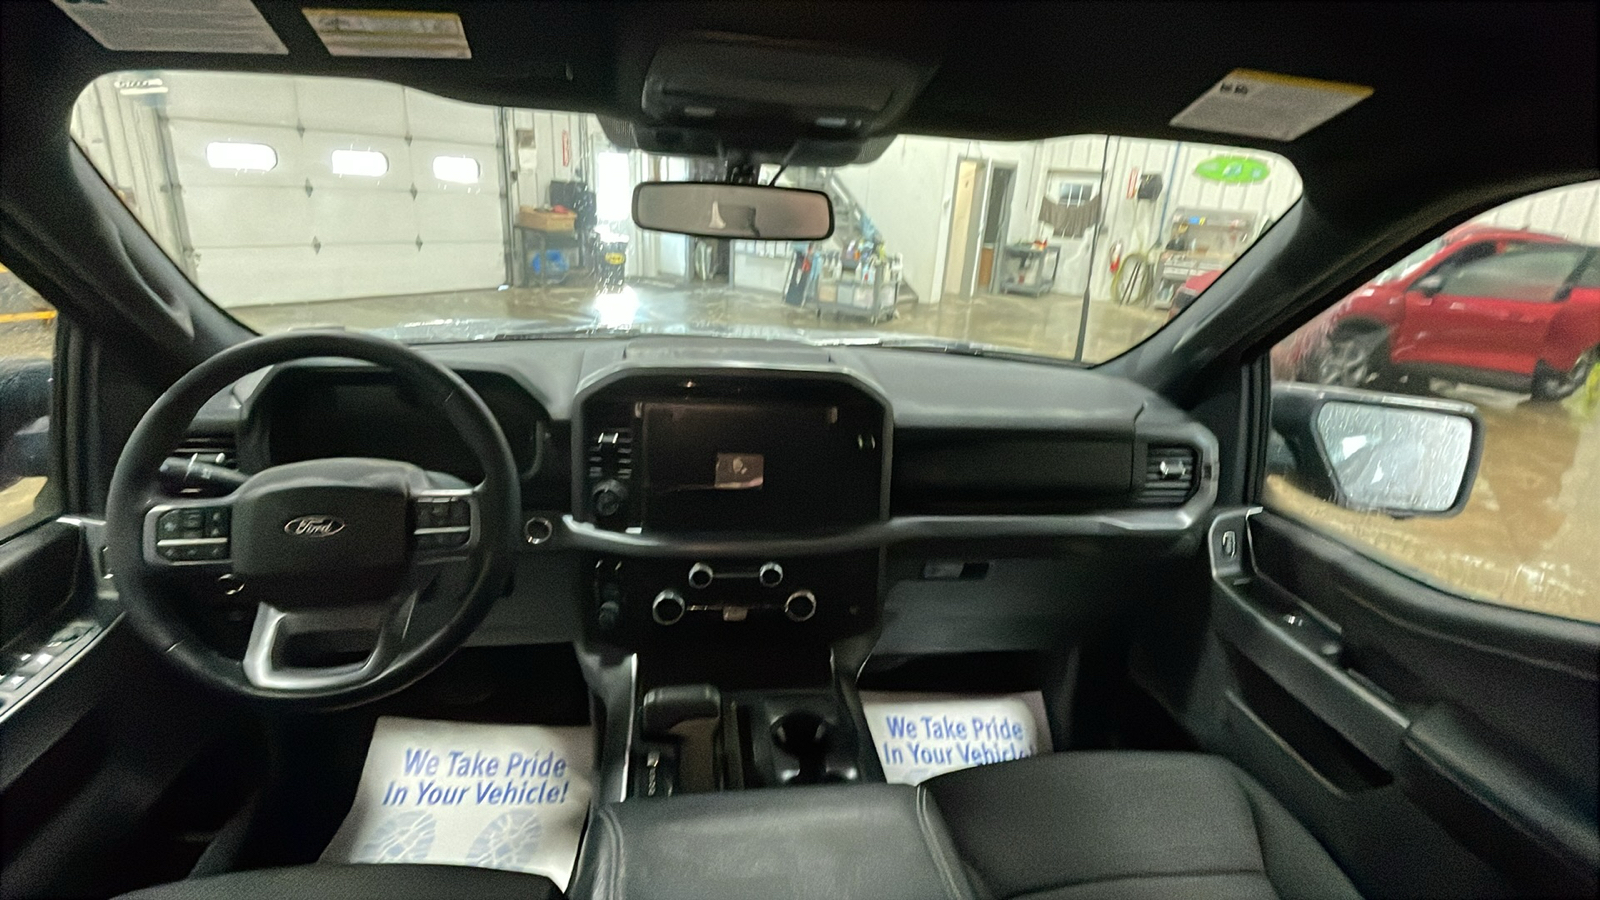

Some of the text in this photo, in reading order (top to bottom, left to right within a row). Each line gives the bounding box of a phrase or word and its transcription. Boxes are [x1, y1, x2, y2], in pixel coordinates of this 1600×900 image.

[295, 517, 334, 535] Ford
[886, 715, 1023, 741] We Take Pride
[404, 748, 566, 778] We Take Pride
[883, 743, 903, 766] In
[907, 743, 952, 766] Your
[383, 780, 569, 806] In Your Vehicle!
